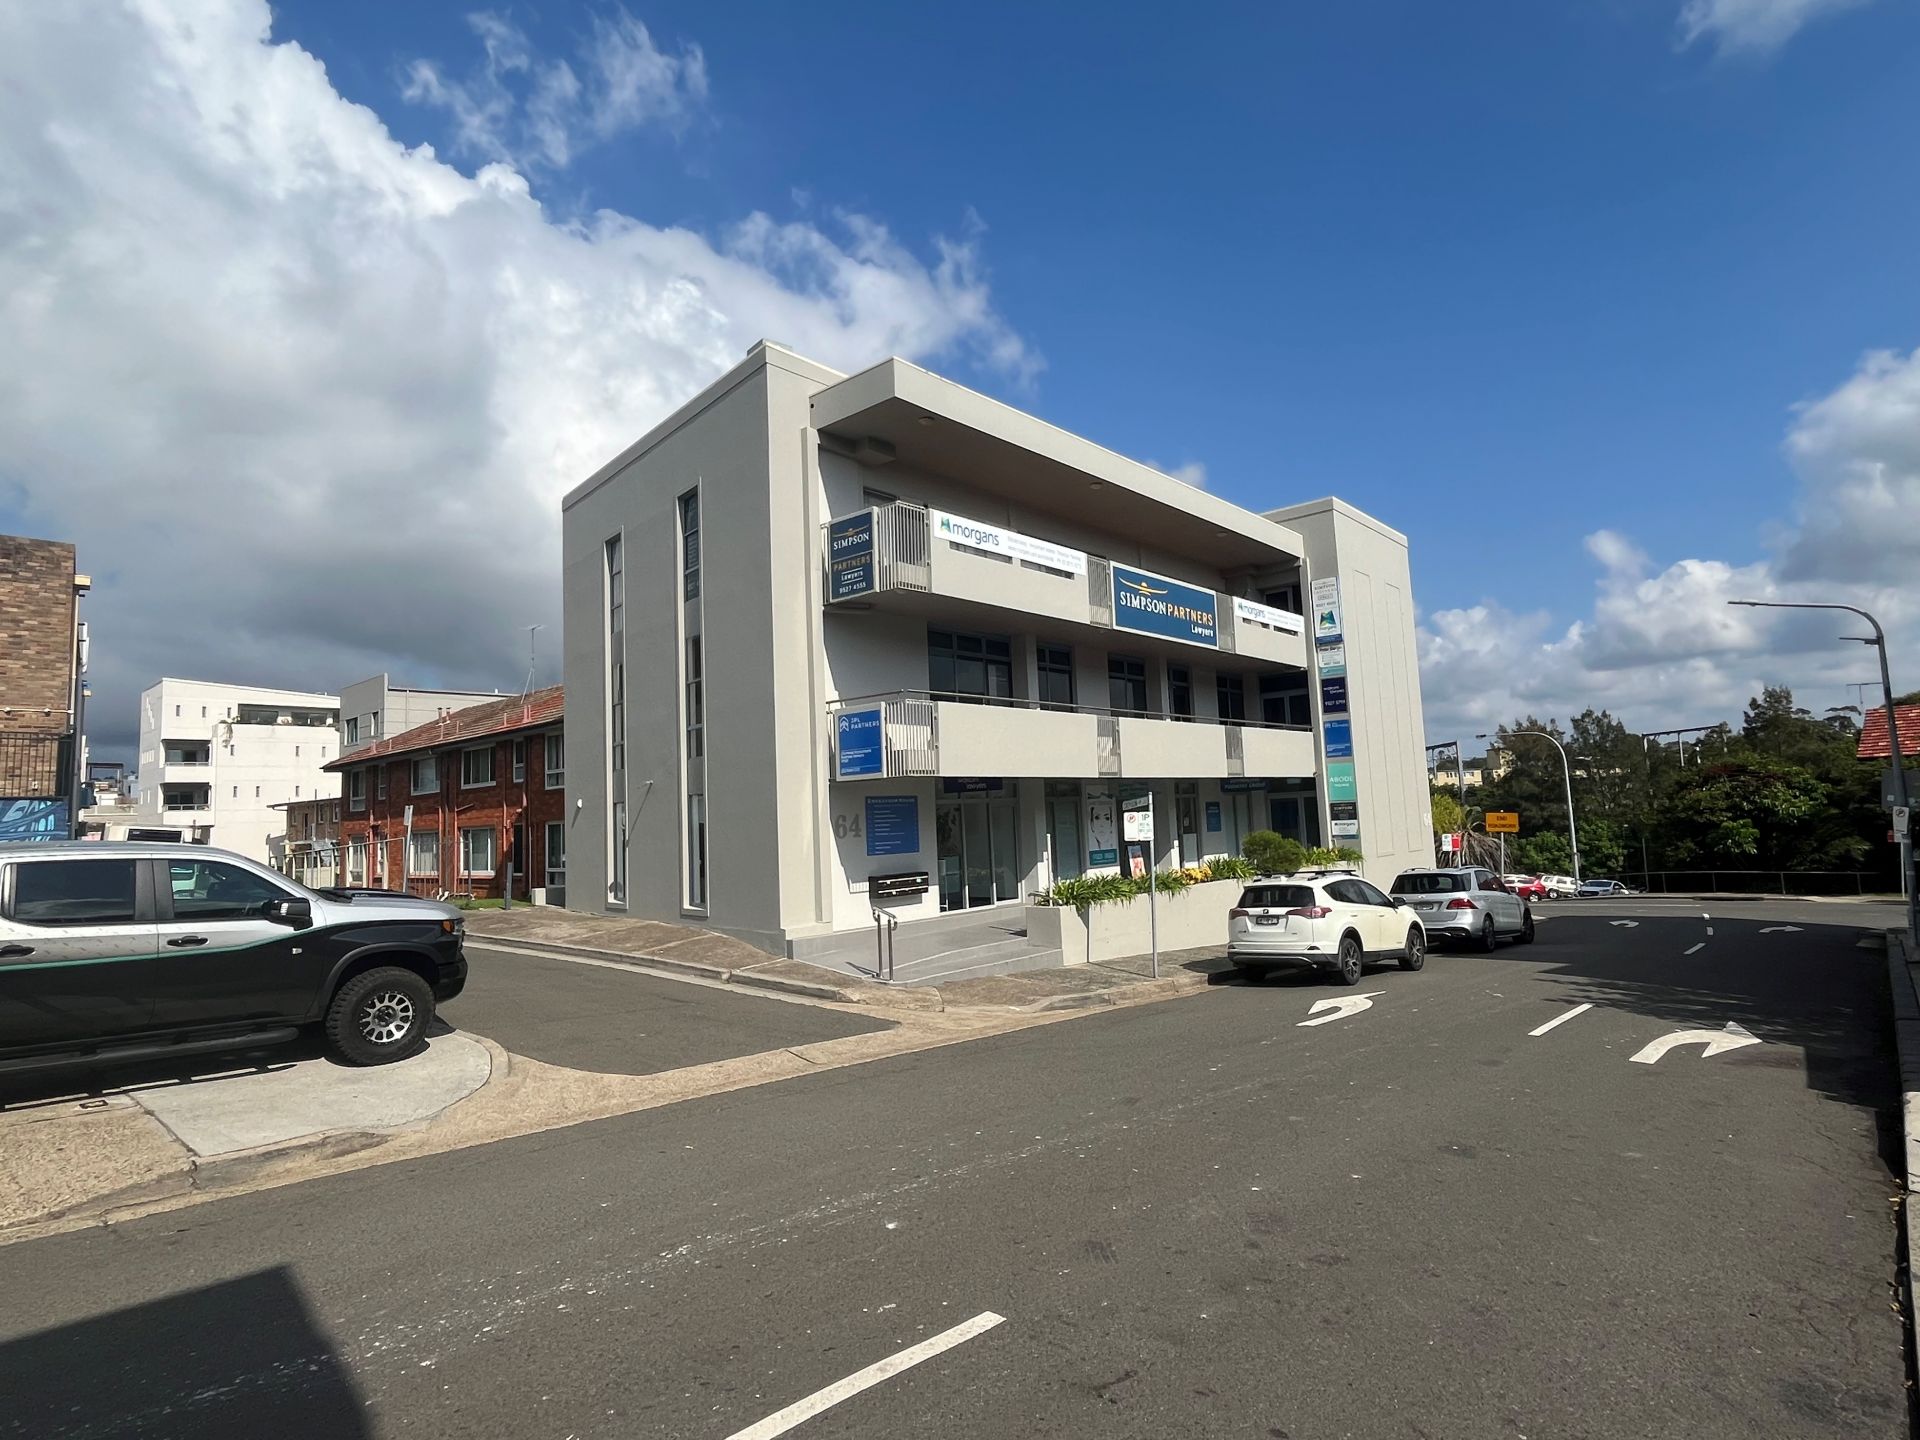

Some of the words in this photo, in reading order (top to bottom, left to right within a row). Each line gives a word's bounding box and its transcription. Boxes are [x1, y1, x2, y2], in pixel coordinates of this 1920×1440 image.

[833, 532, 870, 550] SIMPSON
[952, 523, 999, 546] morgans
[833, 555, 871, 572] PARTNERS
[841, 570, 864, 581] Lawyers
[1244, 603, 1266, 619] morgans
[1191, 624, 1214, 638] Lawyers
[850, 720, 880, 730] PARTNERS
[835, 813, 862, 839] 64
